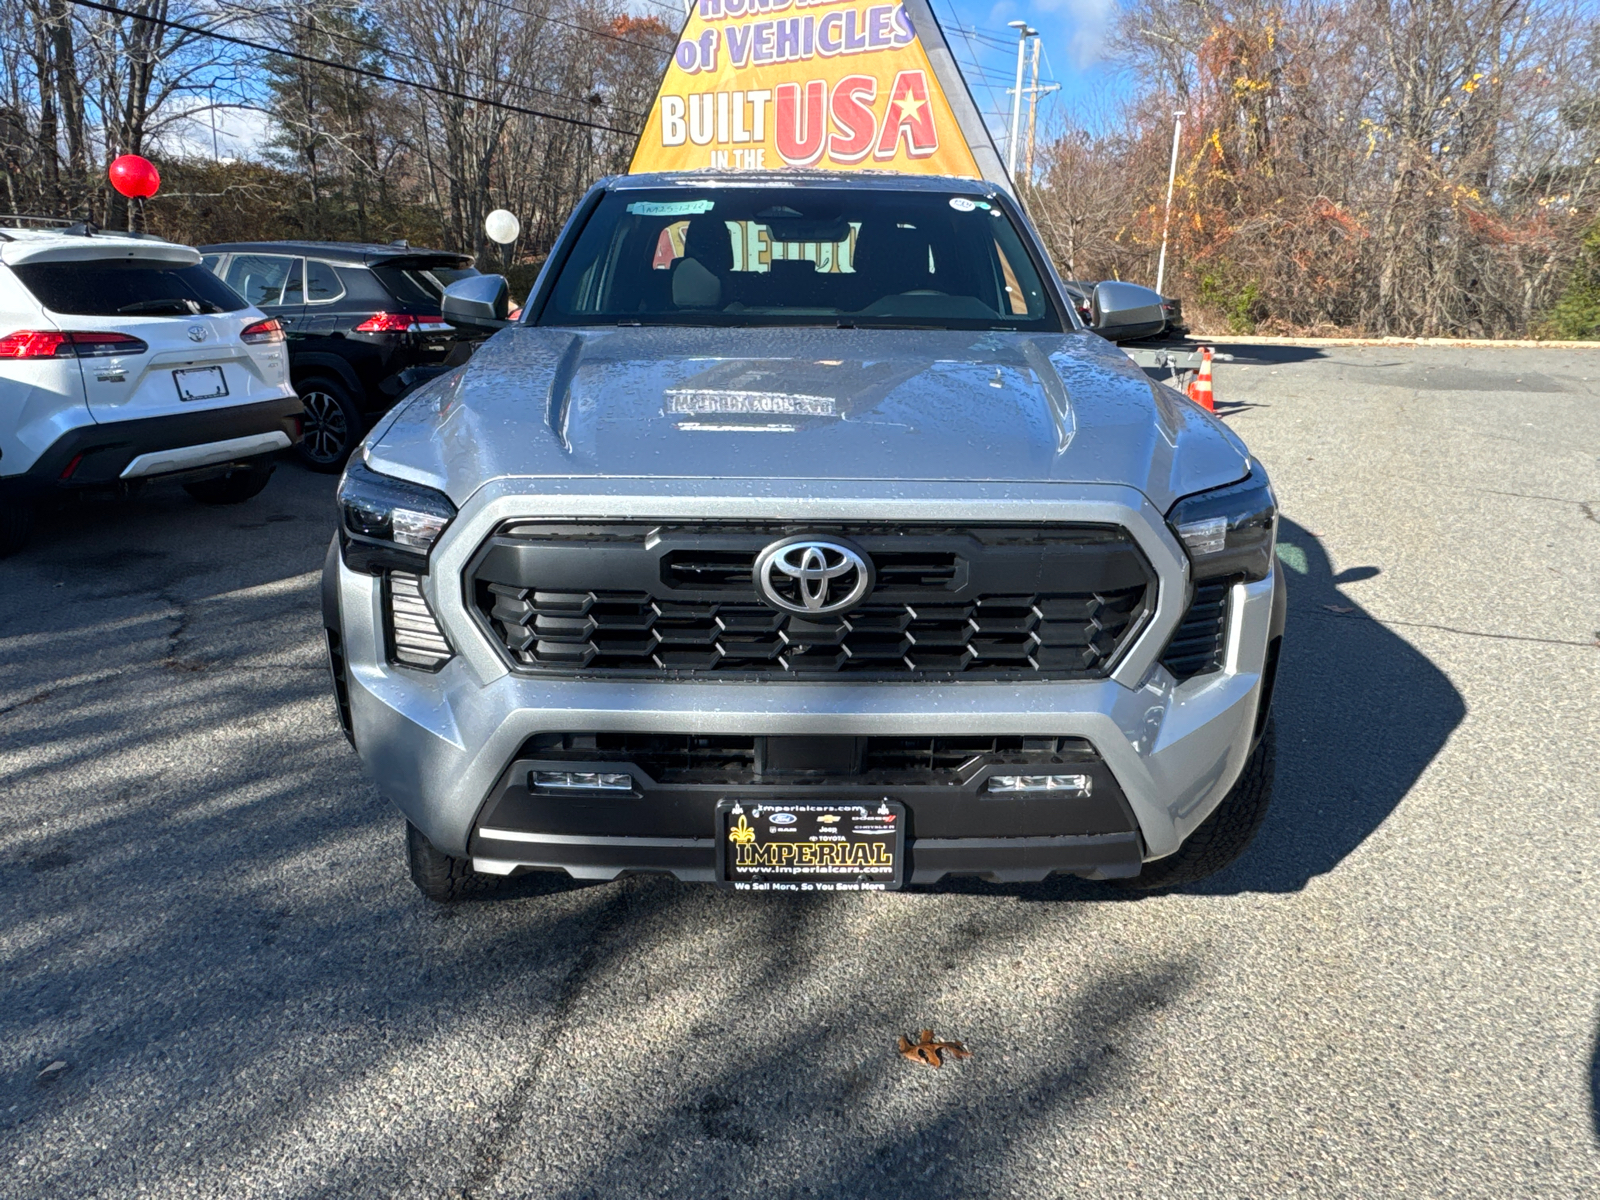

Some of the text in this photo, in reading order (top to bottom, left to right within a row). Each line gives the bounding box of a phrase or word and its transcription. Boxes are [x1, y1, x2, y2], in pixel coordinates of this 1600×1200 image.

[676, 4, 916, 72] of VEHICLES
[661, 70, 939, 165] BUILT USA
[710, 148, 766, 170] IN THE
[818, 826, 838, 834] Jeep
[735, 842, 893, 866] IMPERIAL
[735, 866, 893, 875] www.imperialcars.com
[734, 882, 886, 892] We Sell More, So You Save More
